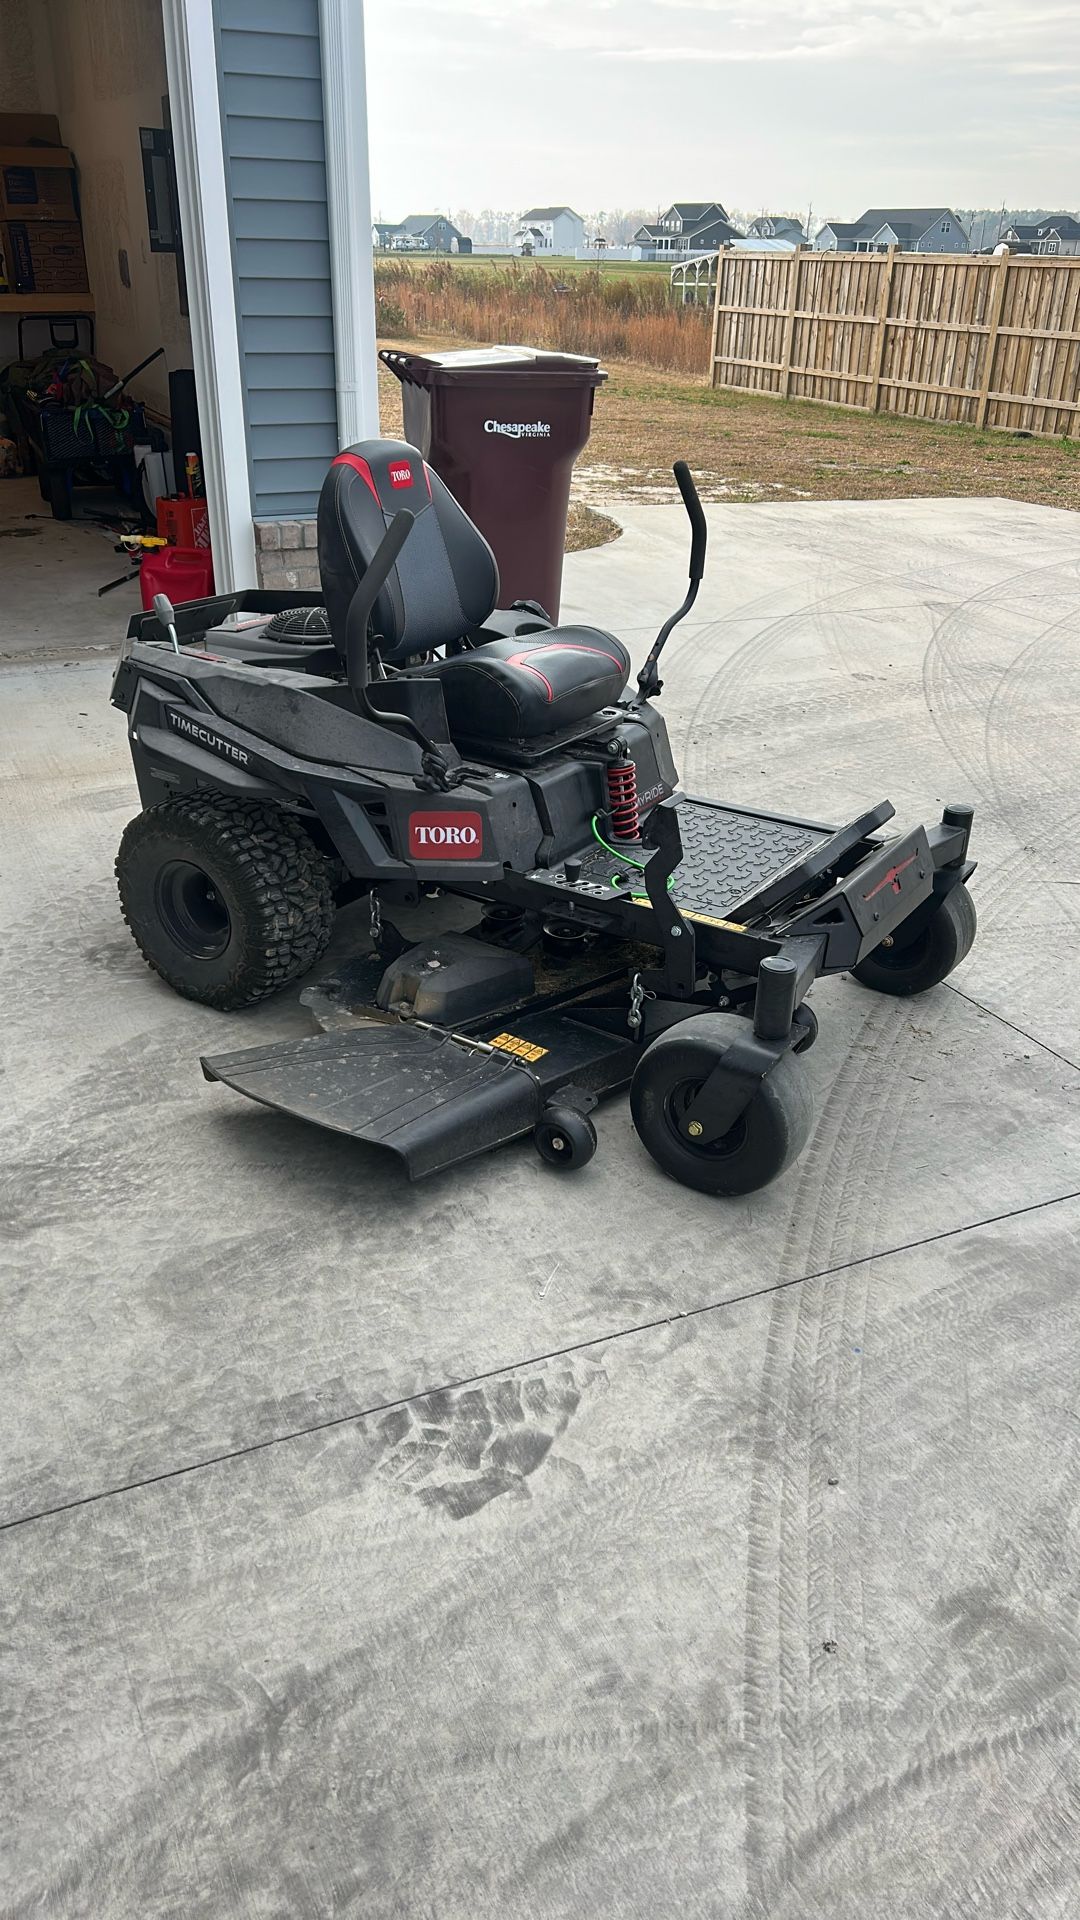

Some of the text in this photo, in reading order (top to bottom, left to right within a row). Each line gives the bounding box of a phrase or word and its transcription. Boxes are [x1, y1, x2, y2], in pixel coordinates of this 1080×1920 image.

[484, 419, 551, 438] Chesapeake
[390, 468, 411, 482] TORO
[169, 712, 249, 766] TIMECUTTER
[415, 826, 477, 844] TORO
